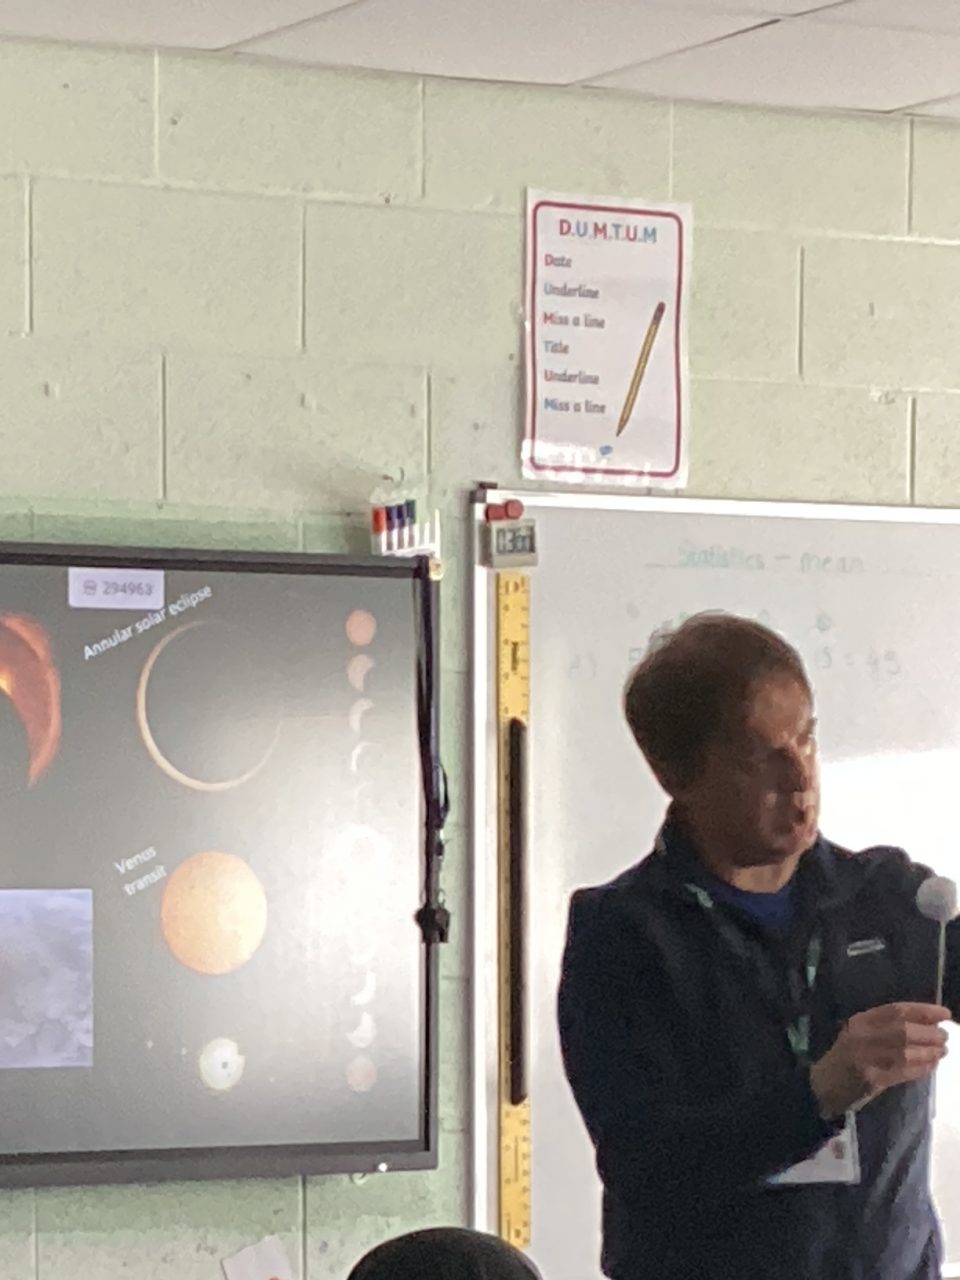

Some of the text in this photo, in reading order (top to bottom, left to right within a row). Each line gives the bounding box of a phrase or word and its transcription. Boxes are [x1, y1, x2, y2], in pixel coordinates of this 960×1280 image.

[544, 254, 572, 269] Date
[544, 283, 600, 299] Underline
[543, 312, 606, 329] Miss a line
[544, 340, 570, 354] Title
[544, 370, 600, 385] Underline
[544, 398, 607, 414] Miss a line
[82, 585, 213, 661] Annular solar eclipse
[114, 845, 157, 876] Venus
[124, 865, 168, 897] transit
